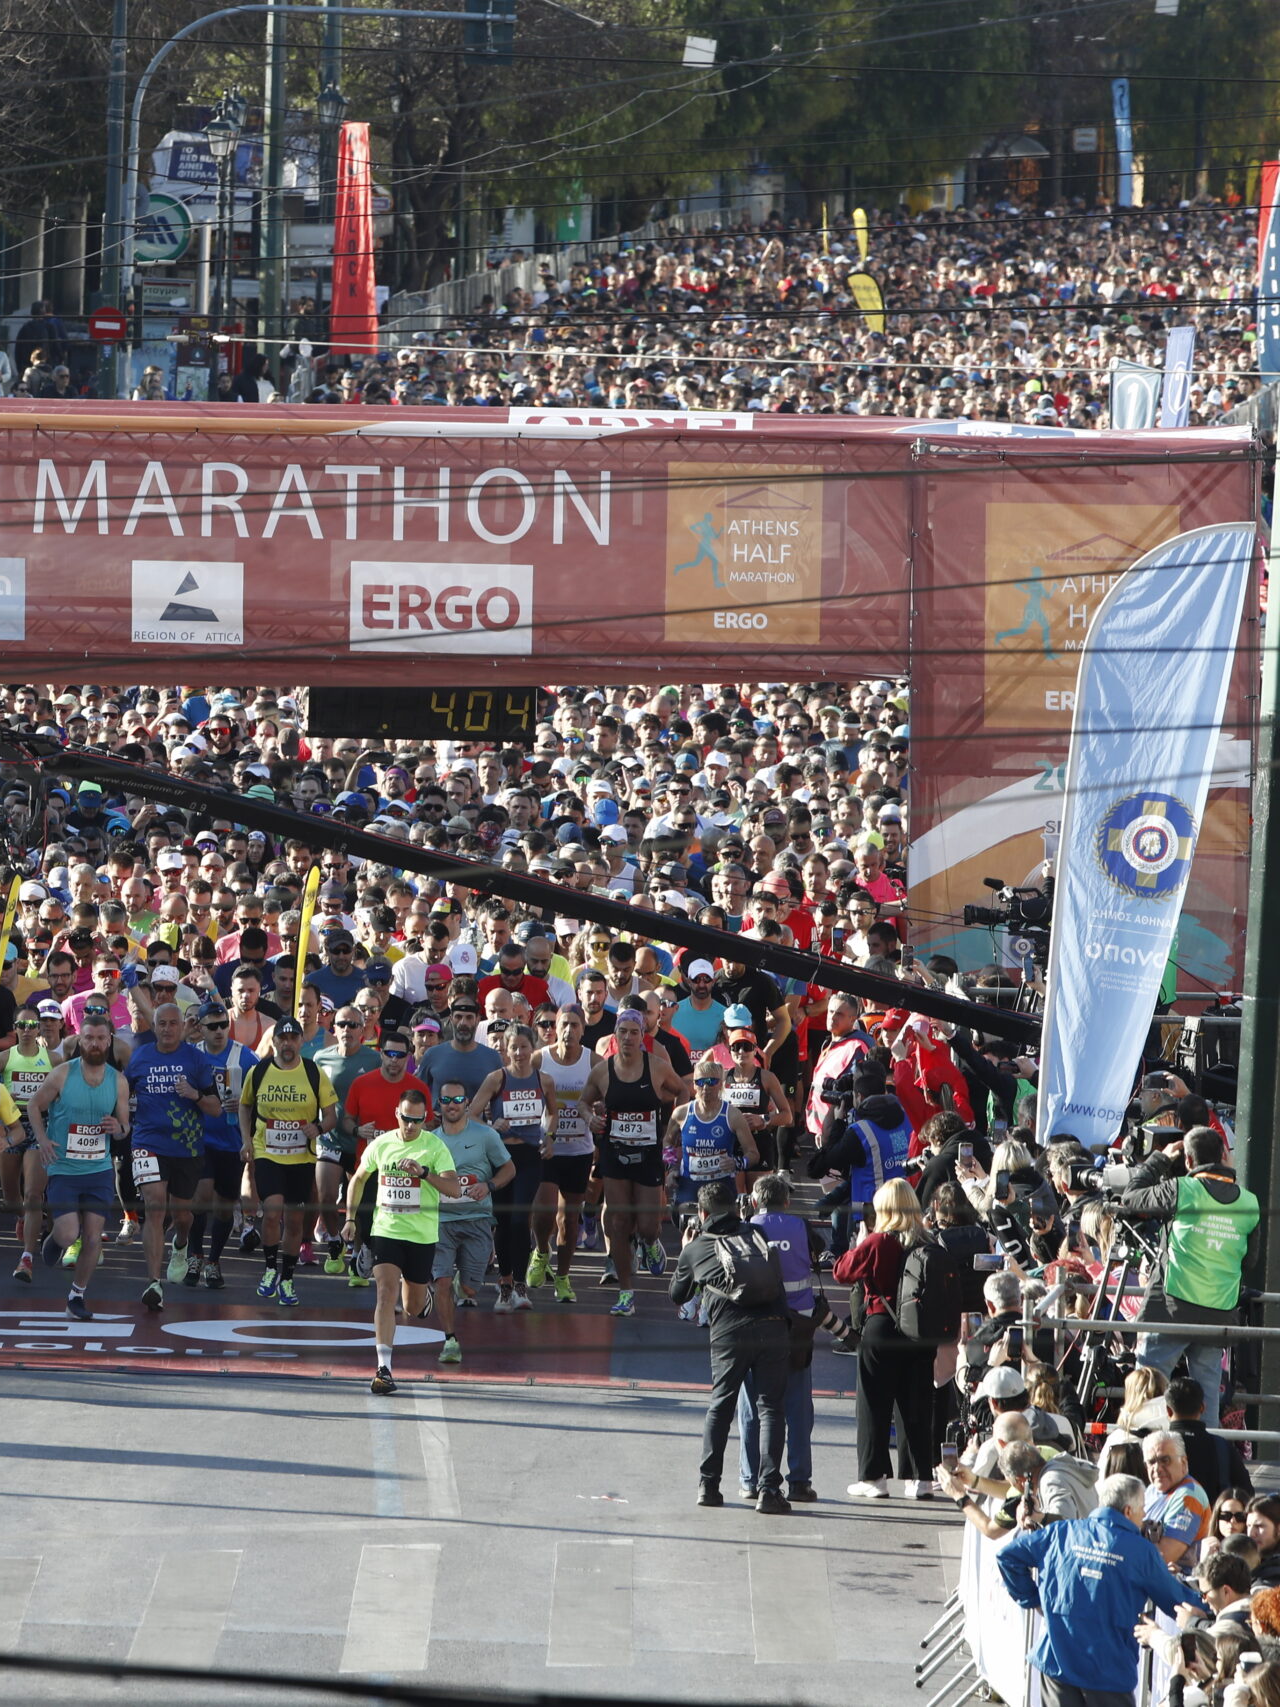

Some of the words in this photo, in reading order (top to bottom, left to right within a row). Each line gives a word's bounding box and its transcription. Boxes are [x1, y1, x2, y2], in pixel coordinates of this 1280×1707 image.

[33, 459, 611, 545] MARATHON
[728, 519, 800, 537] ATHENS
[733, 543, 792, 564] HALF
[729, 571, 795, 584] MARATHON
[361, 585, 521, 632] ERGO
[713, 612, 768, 630] ERGO
[133, 631, 176, 642] REGION
[179, 631, 195, 642] OF
[204, 632, 241, 643] ATTICA
[430, 690, 530, 732] 4.04
[150, 1065, 168, 1074] run
[171, 1064, 183, 1073] to
[18, 1073, 45, 1082] ERGO
[267, 1085, 297, 1094] PACE
[260, 1093, 307, 1103] RUNNER
[509, 1090, 537, 1100] ERGO
[730, 1091, 754, 1100] 4006
[512, 1102, 536, 1112] 4751
[558, 1109, 579, 1118] RGO
[618, 1112, 644, 1121] ERGO
[76, 1125, 101, 1134] ERGO
[273, 1121, 300, 1130] ERGO
[558, 1120, 577, 1130] 874
[618, 1123, 643, 1133] 4873
[77, 1137, 99, 1147] 4096
[275, 1132, 298, 1142] 4974
[385, 1176, 412, 1187] ERGO
[386, 1189, 411, 1200] 4108
[1206, 1238, 1224, 1251] TV
